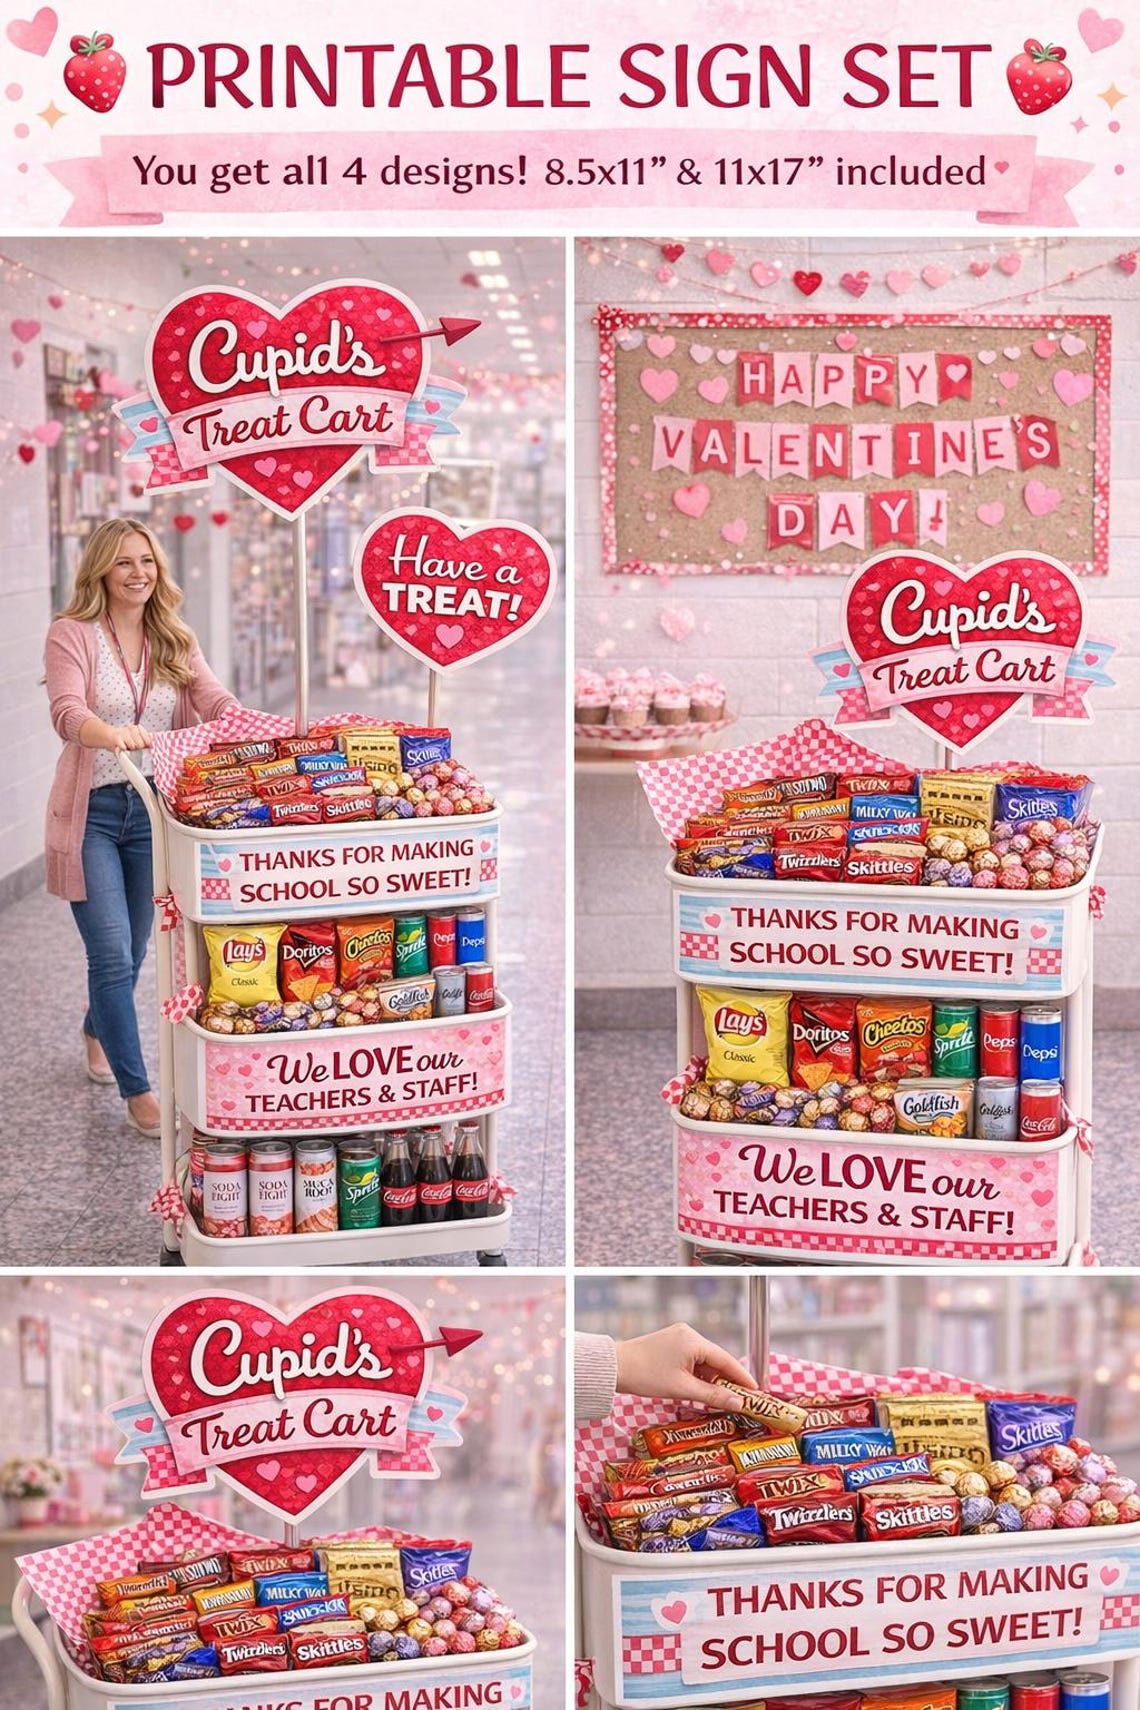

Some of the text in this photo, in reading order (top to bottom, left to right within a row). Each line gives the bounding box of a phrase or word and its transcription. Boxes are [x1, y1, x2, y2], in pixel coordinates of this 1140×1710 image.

[188, 319, 386, 397] Cupid's
[743, 360, 929, 397] HAPPY
[183, 395, 395, 453] Treat Cart
[660, 413, 1053, 465] VALENTINE'S
[388, 533, 523, 586] Have a
[382, 582, 523, 622] TREAT!
[880, 581, 1056, 651] Cupid's
[872, 647, 1057, 695] Treat Cart
[239, 838, 475, 873] THANKS FOR MAKING
[240, 867, 472, 904] SCHOOL SO SWEET!
[730, 906, 1020, 940] THANKS FOR MAKING
[283, 943, 334, 961] Doritos
[730, 941, 1014, 976] SCHOOL SO SWEET!
[793, 1023, 850, 1042] Doritos
[864, 1016, 927, 1047] Cheetos
[266, 1045, 464, 1086] We LOVE our
[245, 1072, 479, 1114] TEACHERS & STAFF!
[903, 1094, 960, 1116] Goldfish
[738, 1144, 1002, 1201] We LOVE our
[713, 1190, 1015, 1236] TEACHERS & STAFF!
[190, 1319, 393, 1399] Cupid's
[182, 1397, 398, 1456] Treat Cart
[1001, 1421, 1063, 1451] Skittles
[756, 1473, 822, 1499] TWIX
[765, 1505, 853, 1531] Twizzlers
[875, 1504, 954, 1532] Skittles
[707, 1561, 1091, 1618] THANKS FOR MAKING
[296, 1637, 364, 1661] Skittles
[701, 1607, 1084, 1670] SCHOOL SO SWEET!
[384, 1681, 503, 1710] MAKING
